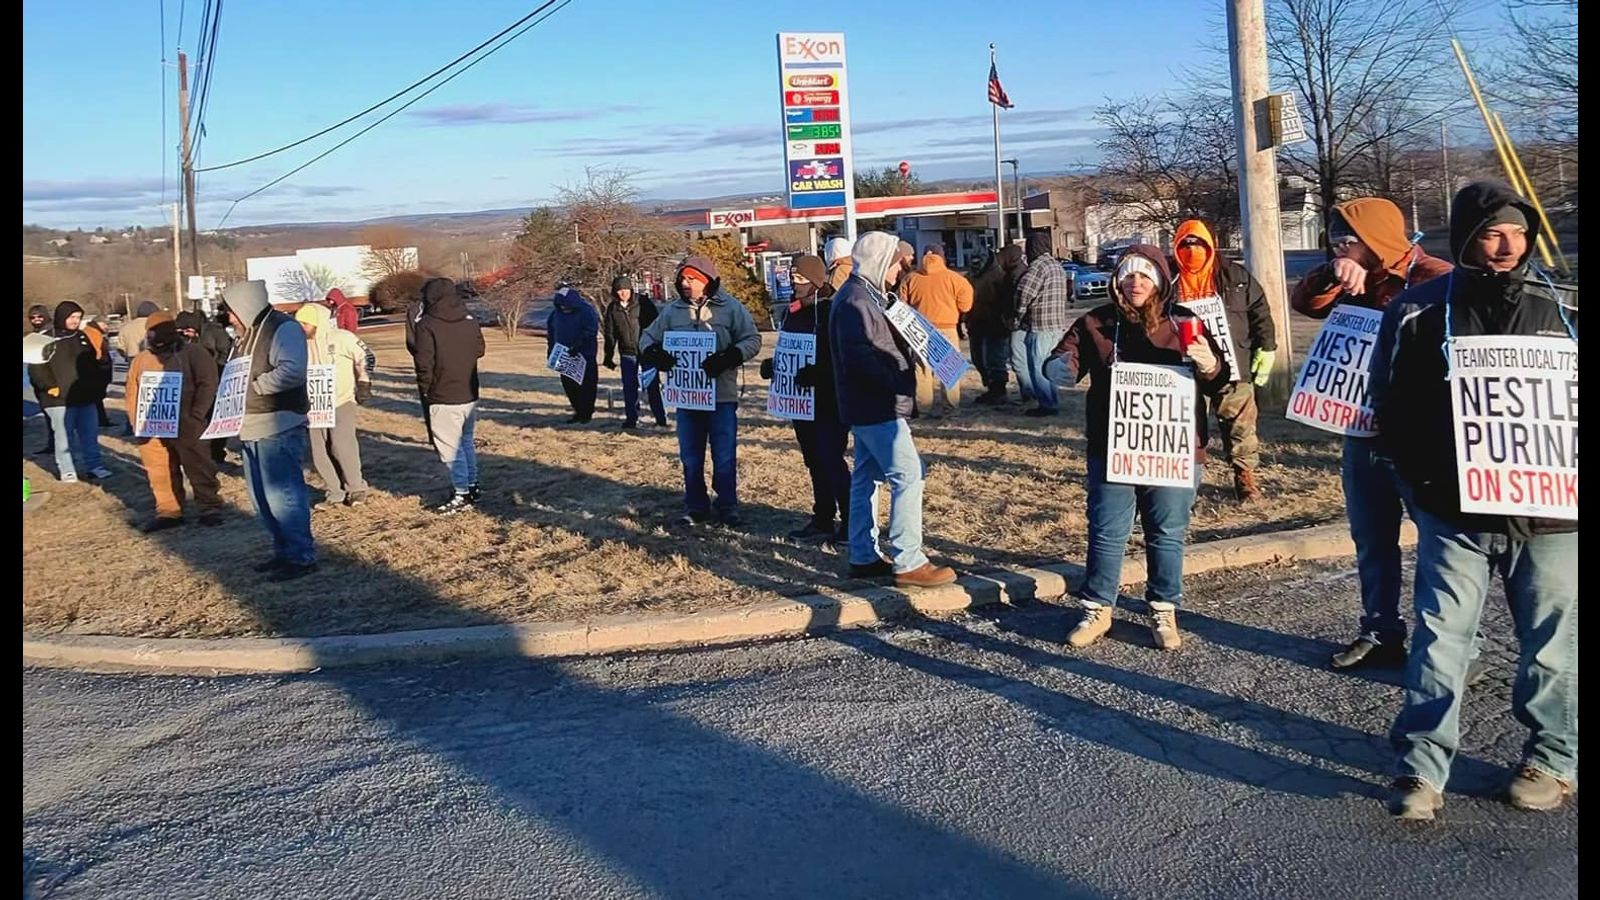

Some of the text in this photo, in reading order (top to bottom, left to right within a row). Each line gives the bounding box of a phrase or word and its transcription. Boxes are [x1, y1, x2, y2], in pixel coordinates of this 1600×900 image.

[786, 37, 840, 61] Exxon
[792, 179, 843, 191] CAR WASH
[714, 211, 752, 227] EXXON
[1329, 311, 1380, 335] TEAMSTER LOC
[688, 337, 703, 348] LOCAL
[790, 338, 803, 350] LOCAL
[803, 339, 814, 351] 773
[1313, 330, 1372, 369] NEST
[774, 352, 813, 373] ESTL
[1455, 347, 1578, 372] TEAMSTER LOCAL 773
[308, 378, 333, 394] STLE
[667, 369, 712, 389] PURINA
[770, 373, 811, 396] URINA
[1115, 370, 1177, 388] TEAMSTER LOCA
[1300, 360, 1373, 408] PURIN
[140, 386, 178, 402] NESTLE
[308, 395, 333, 410] RINA
[666, 388, 712, 406] ON STRIKE
[138, 403, 176, 420] PURINA
[778, 396, 812, 415] STRIKE
[1293, 391, 1376, 431] ON STRIK
[1113, 422, 1190, 454] PURINA
[1112, 453, 1189, 481] ON STRIKE
[1466, 467, 1578, 507] ON STRIK
